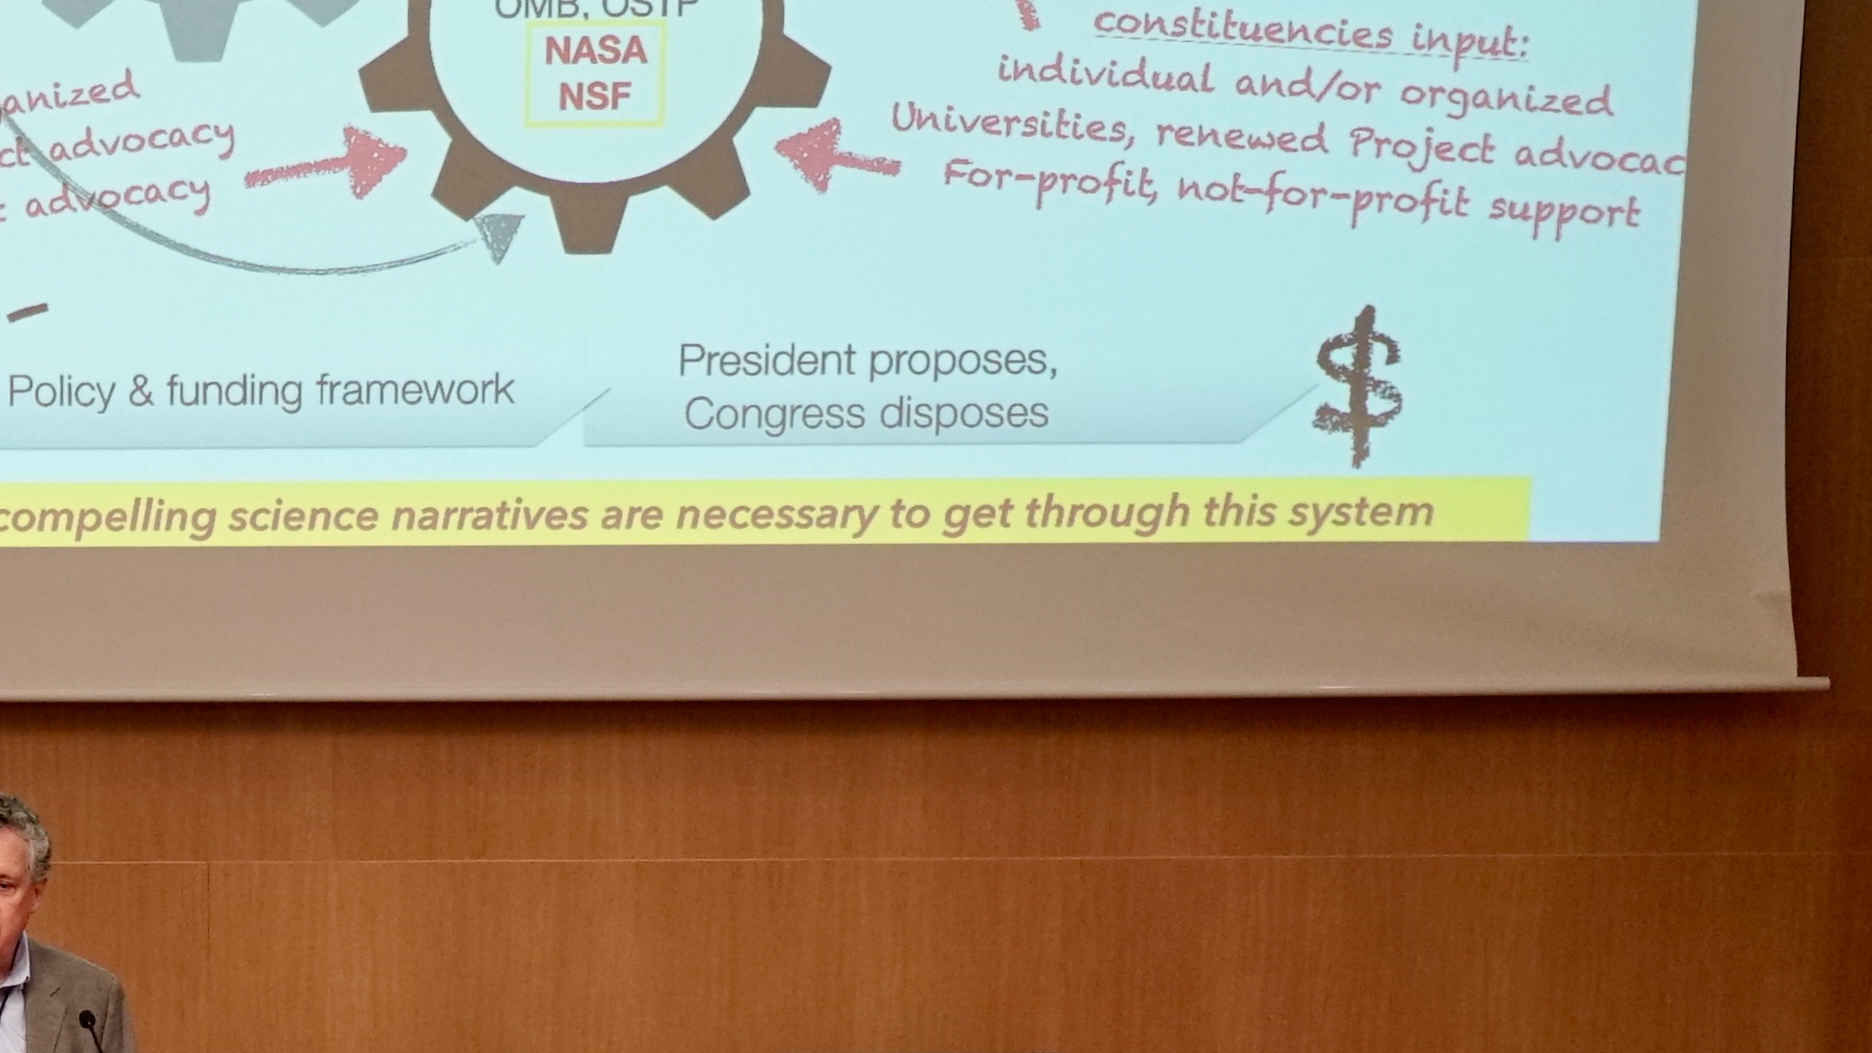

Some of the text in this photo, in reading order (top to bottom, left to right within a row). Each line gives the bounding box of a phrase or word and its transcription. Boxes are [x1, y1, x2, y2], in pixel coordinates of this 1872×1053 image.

[494, 0, 700, 21] OMB, OSTP
[545, 33, 648, 66] NASA
[1093, 7, 1530, 72] constituencies input:
[559, 80, 632, 111] NSF
[997, 51, 1615, 120] individual and/or organized
[49, 124, 235, 161] advocacy
[891, 101, 1687, 176] Universities, renewed Project advocac
[25, 178, 211, 217] advocacy
[944, 158, 1642, 242] For-profit, not-for-profit support
[679, 342, 1058, 383] President proposes,
[7, 372, 517, 414] Policy & funding framework
[685, 395, 1050, 437] Congress disposes
[228, 498, 379, 532] science
[391, 496, 589, 532] narratives
[601, 504, 664, 530] are
[675, 503, 880, 539] necessary
[890, 498, 932, 529] to
[941, 498, 1015, 539] get
[1025, 492, 1191, 538] through
[1203, 493, 1277, 527] this
[1287, 497, 1435, 536] system
